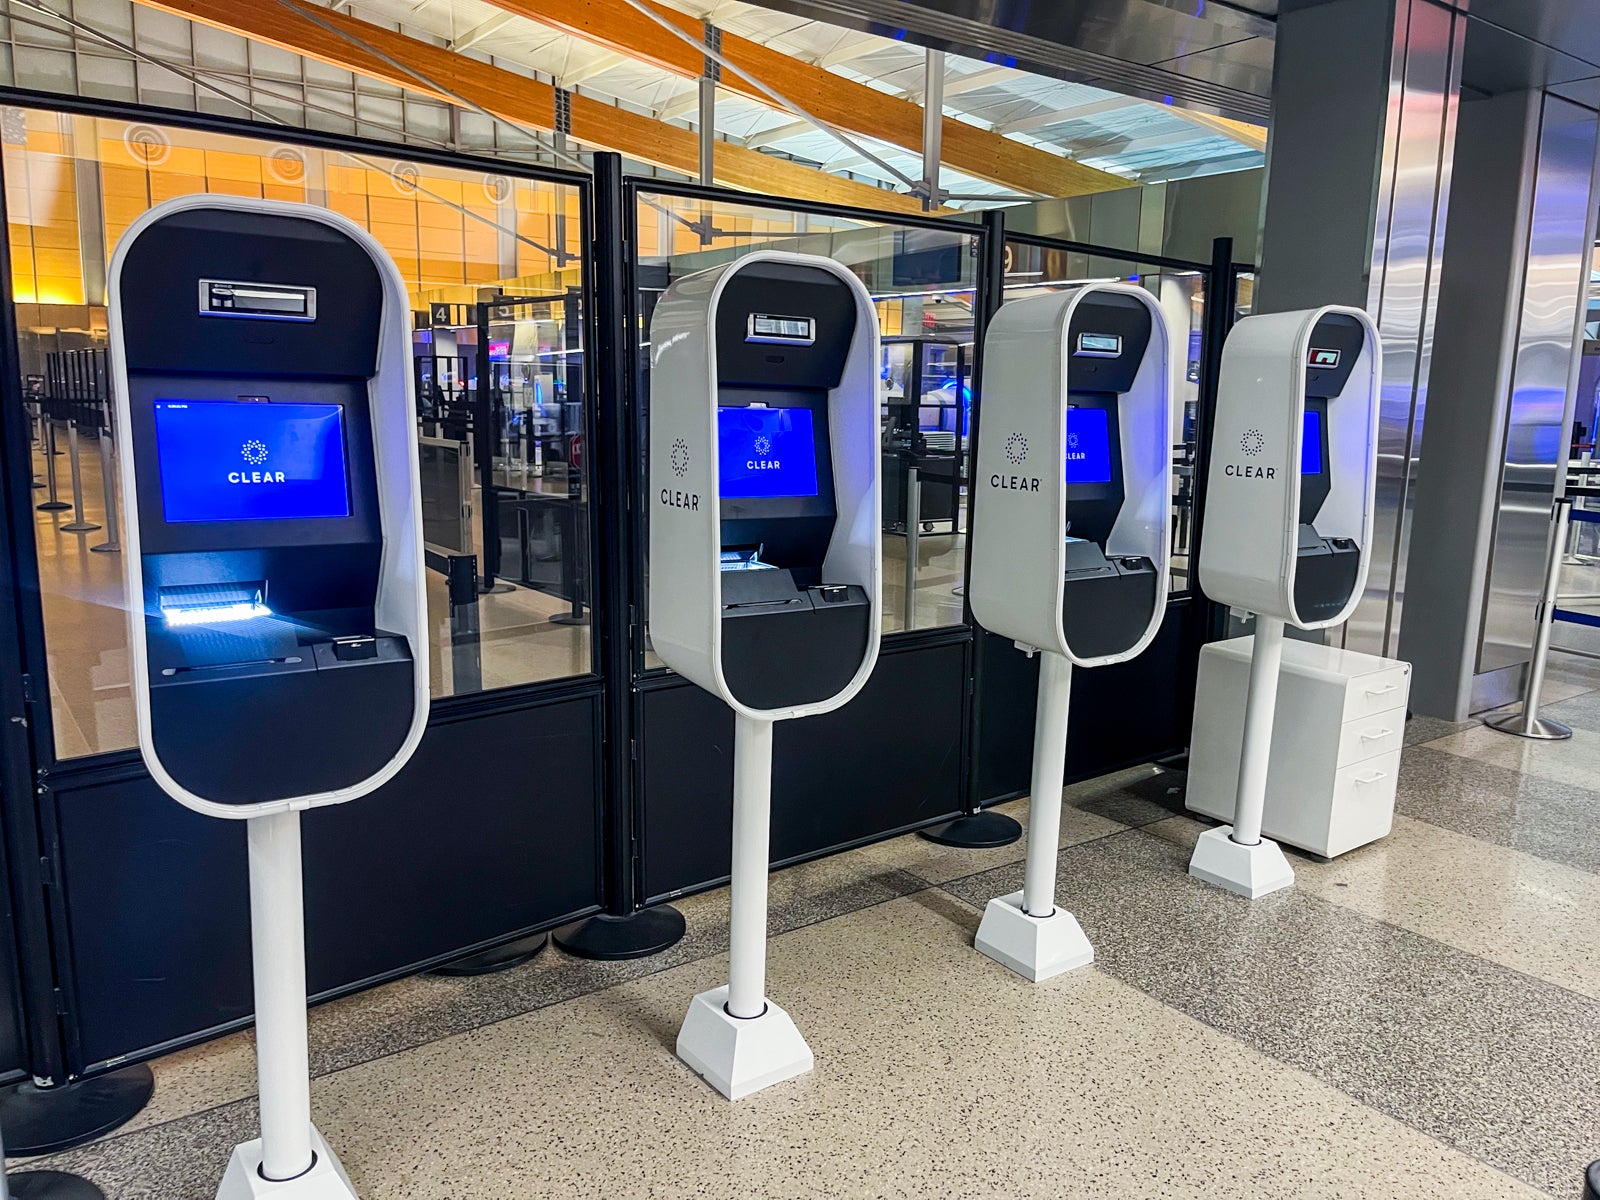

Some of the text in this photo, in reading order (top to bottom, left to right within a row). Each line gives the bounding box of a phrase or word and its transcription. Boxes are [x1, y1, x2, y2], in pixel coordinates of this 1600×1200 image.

[435, 306, 447, 322] 4
[745, 460, 781, 470] CLEAR
[1224, 464, 1276, 480] CLEAR
[227, 471, 286, 484] CLEAR
[990, 474, 1041, 492] CLEAR
[660, 488, 699, 512] CLEAR
